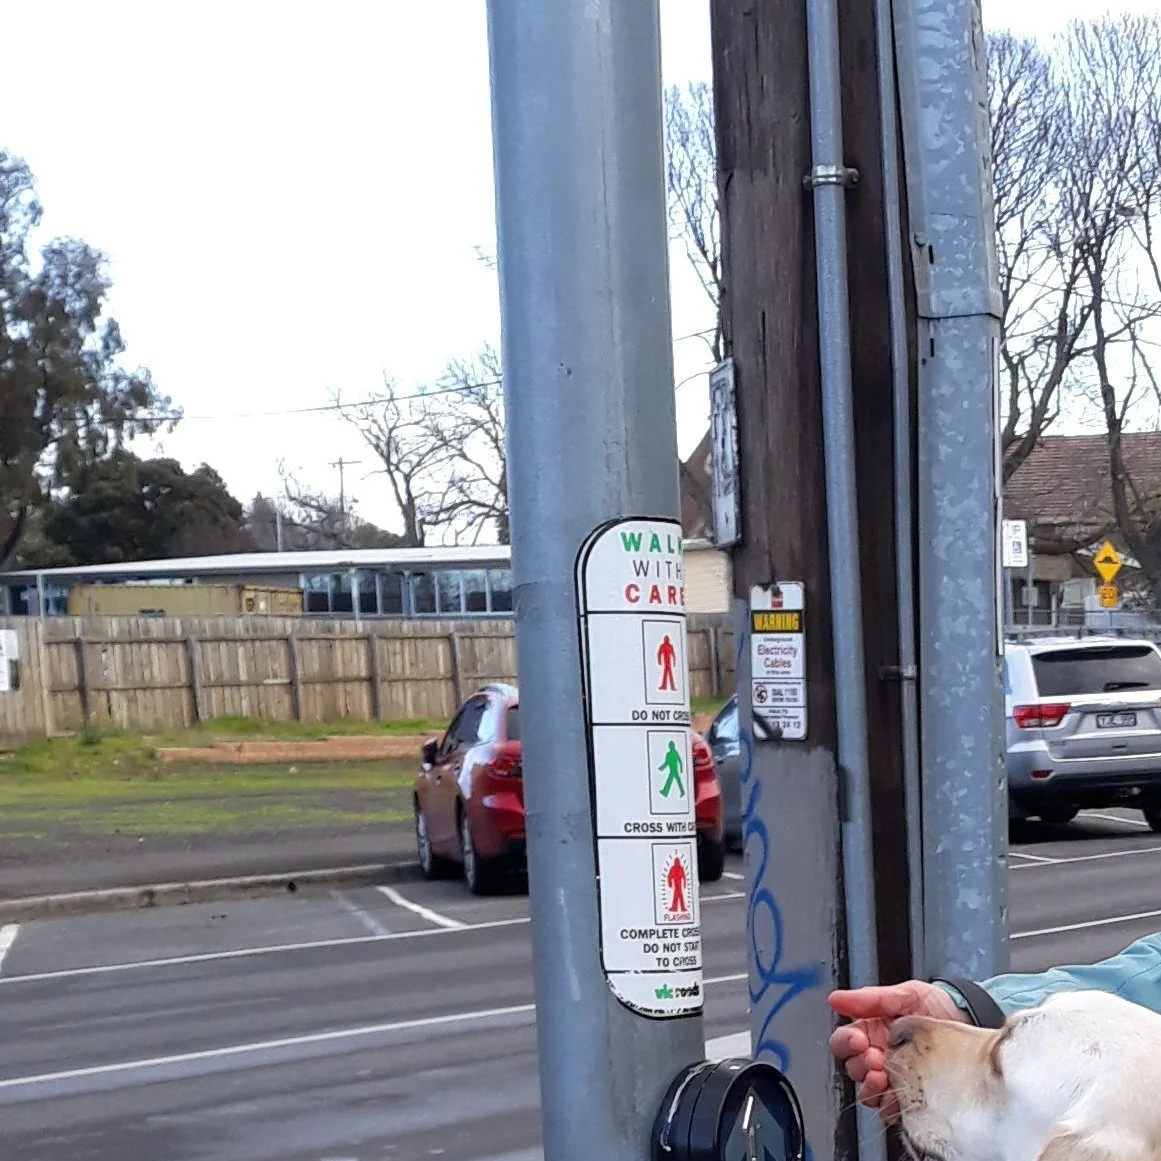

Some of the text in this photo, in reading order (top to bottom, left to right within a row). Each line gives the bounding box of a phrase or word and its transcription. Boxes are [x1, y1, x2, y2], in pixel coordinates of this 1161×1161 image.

[754, 612, 799, 630] WARNING
[757, 644, 797, 658] Electricity
[763, 657, 792, 668] Cables
[632, 710, 648, 721] DO
[652, 710, 671, 721] NOT
[624, 822, 663, 833] CROSS
[666, 822, 686, 832] WITH
[620, 928, 679, 939] COMPLETE
[643, 943, 659, 954] DO
[662, 942, 681, 953] NOT
[656, 957, 670, 967] TO
